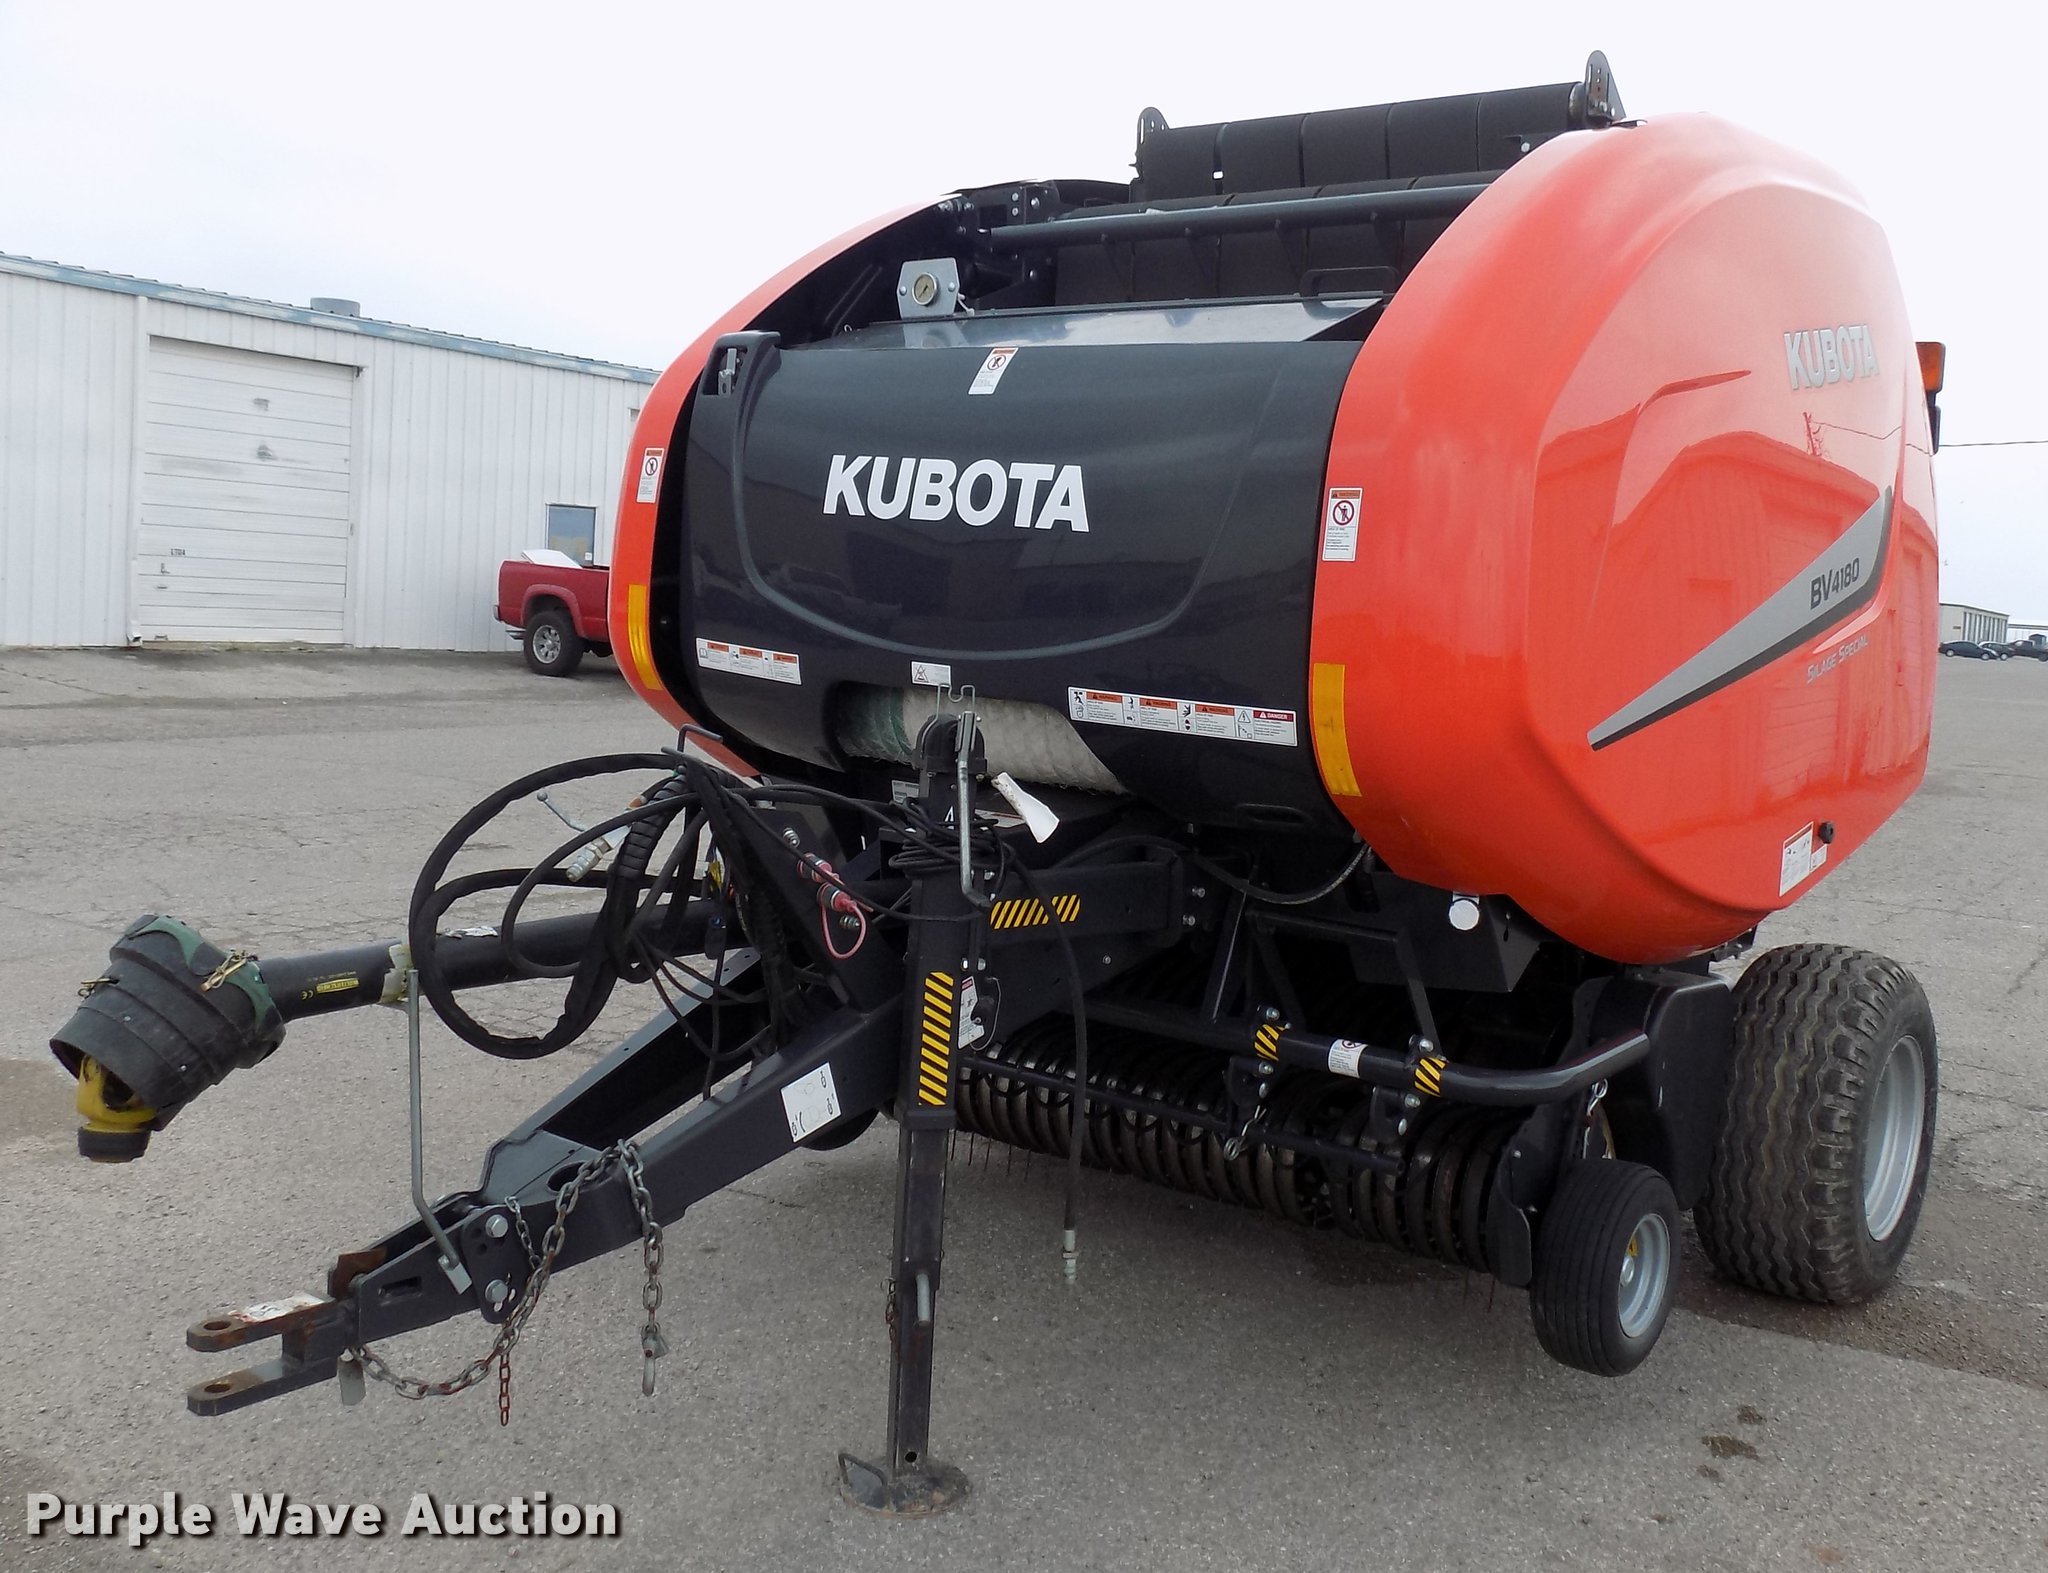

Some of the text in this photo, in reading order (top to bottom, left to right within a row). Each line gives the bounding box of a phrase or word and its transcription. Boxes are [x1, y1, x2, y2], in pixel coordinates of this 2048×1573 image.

[1783, 323, 1880, 391] KUBOTA
[823, 454, 1090, 533] KUBOTA
[1810, 557, 1860, 610] BV4180
[1266, 712, 1293, 721] DANGER
